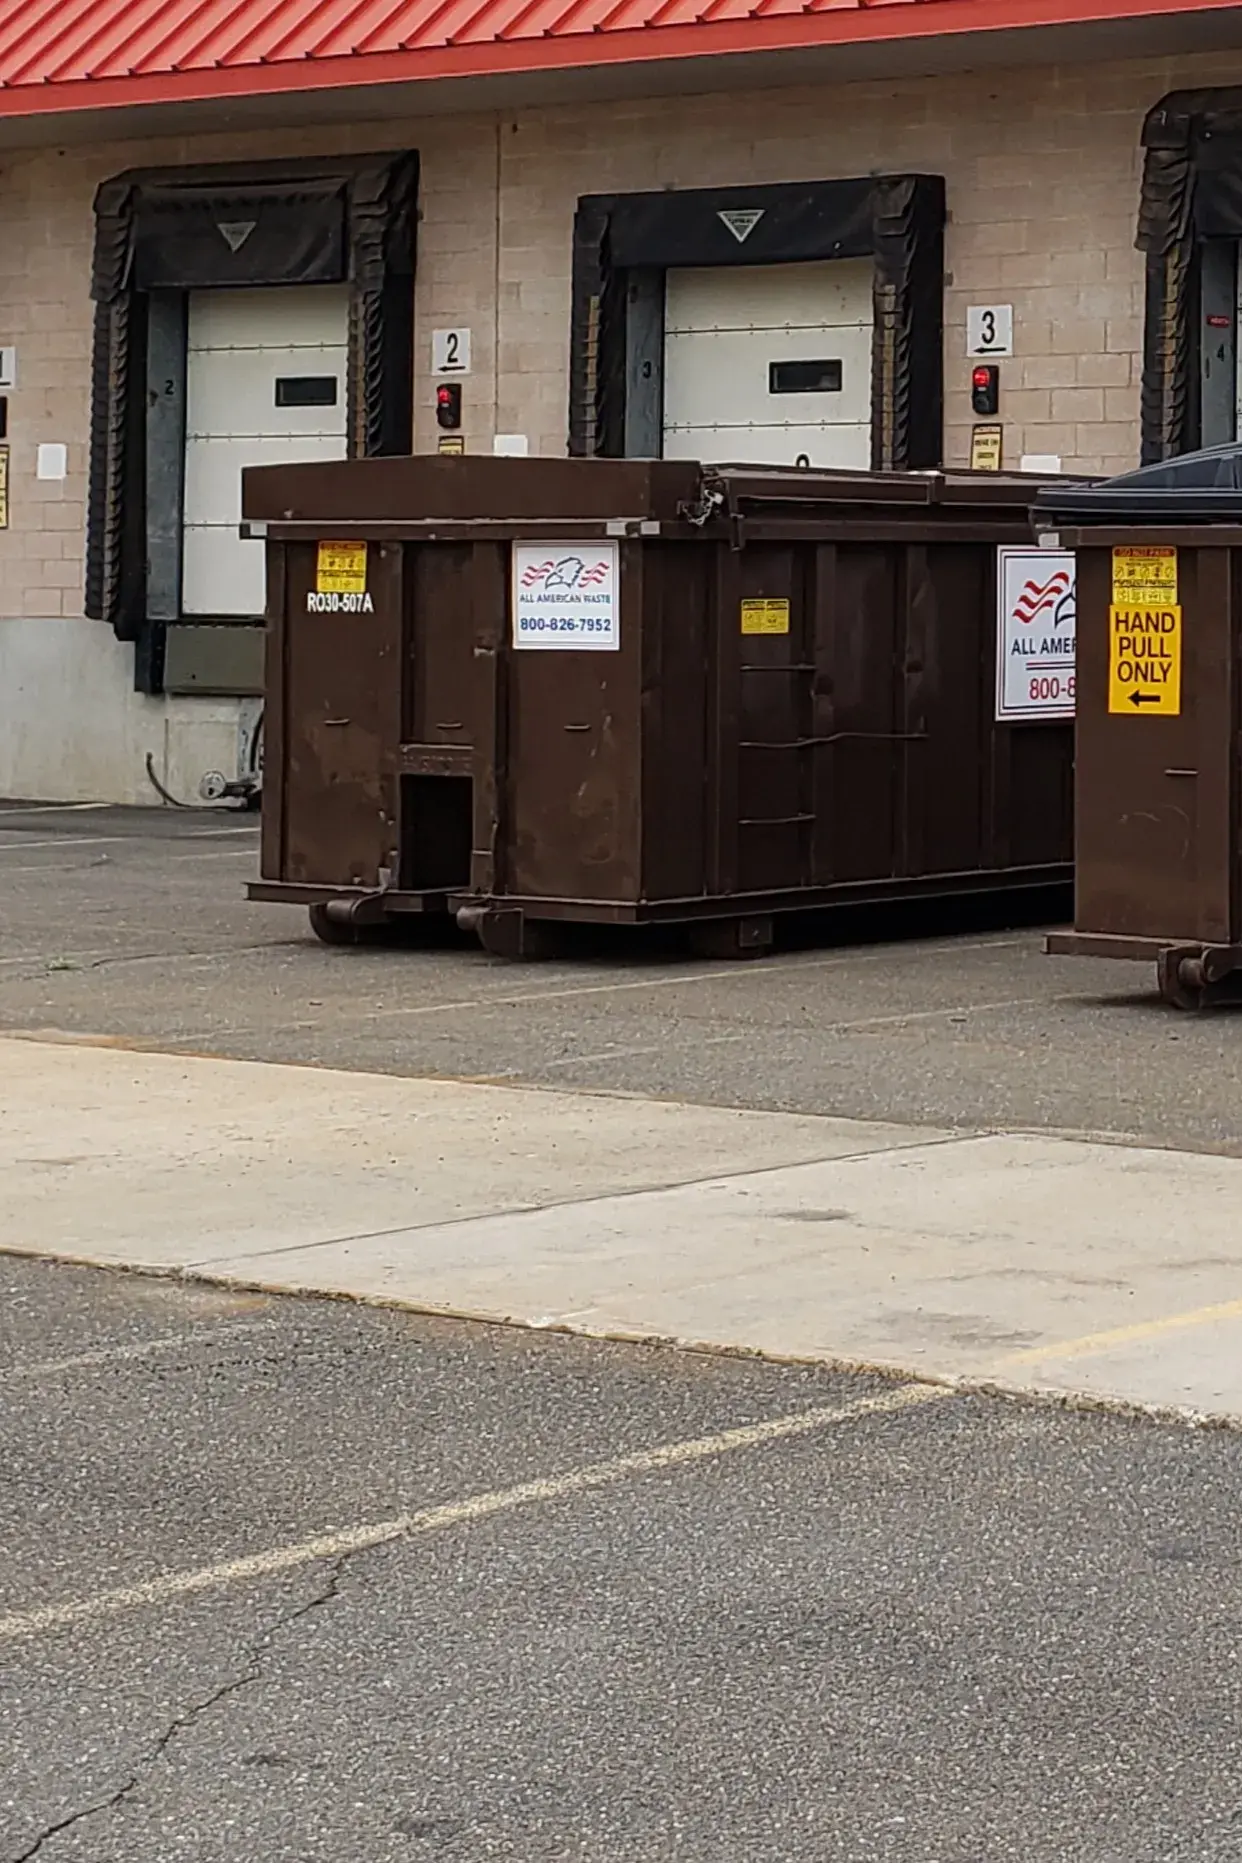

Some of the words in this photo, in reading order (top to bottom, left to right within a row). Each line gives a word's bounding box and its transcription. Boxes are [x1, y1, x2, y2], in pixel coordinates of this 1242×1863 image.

[982, 311, 995, 345] 3
[446, 333, 459, 363] 2
[165, 379, 174, 395] 2
[307, 592, 374, 613] RO30-507A
[520, 594, 534, 603] ALL
[537, 594, 581, 603] AMERICAN
[584, 594, 611, 604] WASTE
[520, 618, 611, 631] 800-826-7952
[1115, 612, 1175, 633] HAND
[1011, 638, 1036, 655] ALL
[1119, 637, 1171, 658] PULL
[1117, 660, 1172, 683] ONLY
